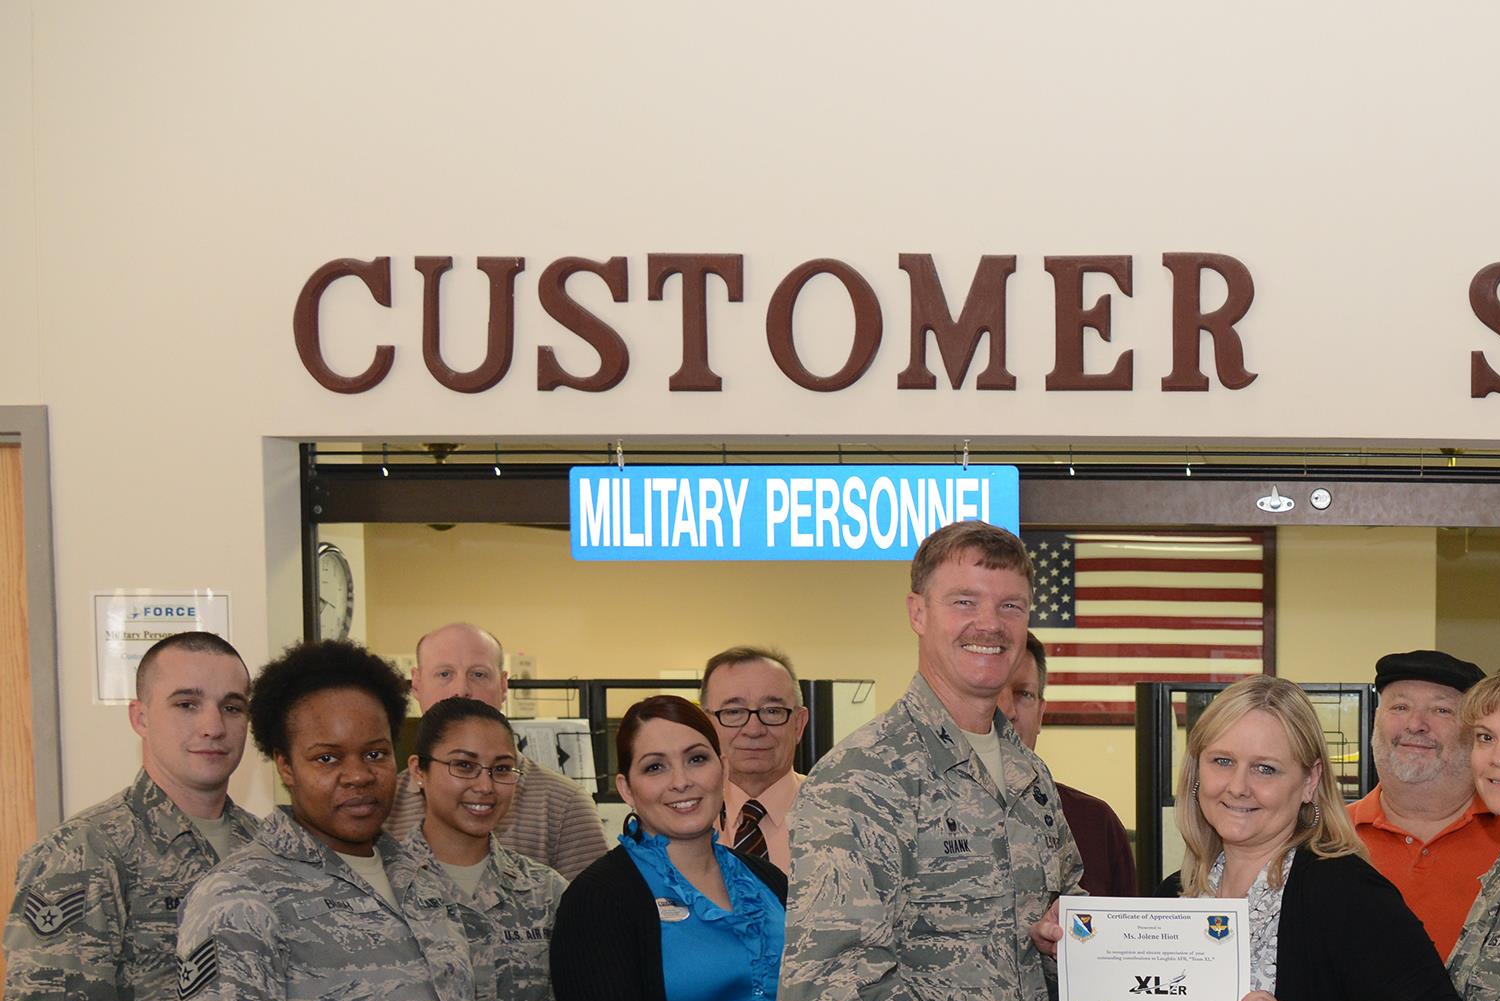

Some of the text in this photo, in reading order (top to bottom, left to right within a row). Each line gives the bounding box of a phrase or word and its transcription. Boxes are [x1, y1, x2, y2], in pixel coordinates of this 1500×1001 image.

[293, 252, 1258, 393] CUSTOMER
[580, 477, 748, 548] MILITARY
[143, 606, 196, 617] FORCE
[943, 839, 971, 854] SHANK
[1150, 913, 1191, 921] Appreciation
[526, 928, 543, 940] AIR
